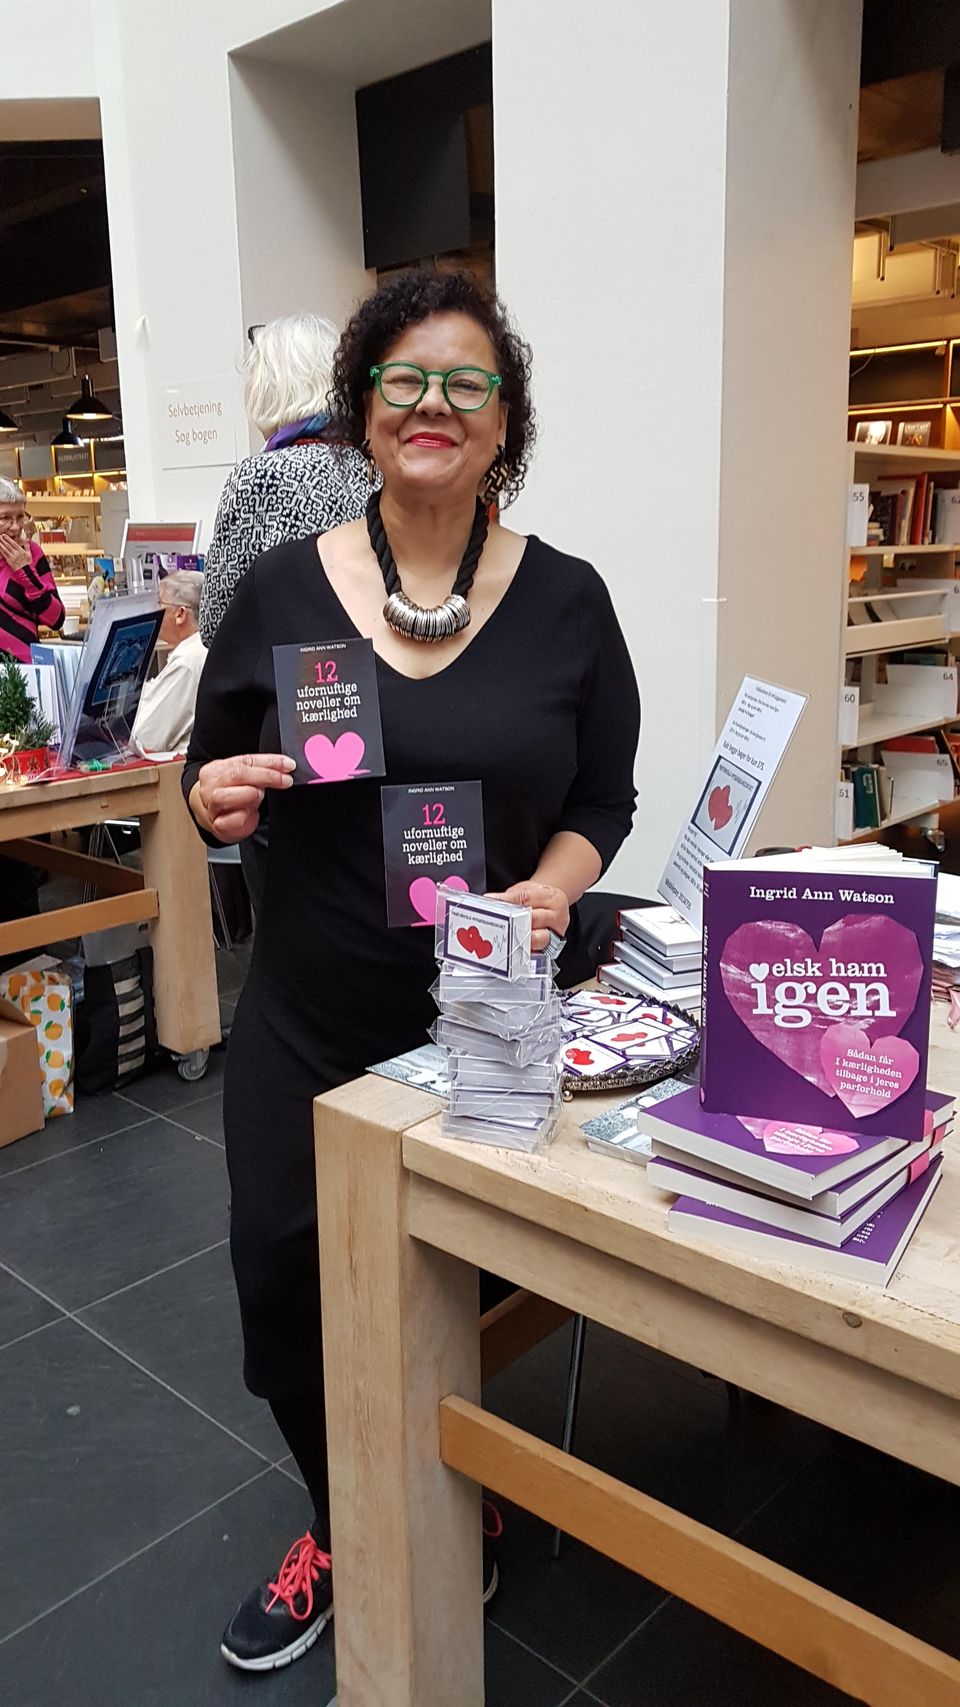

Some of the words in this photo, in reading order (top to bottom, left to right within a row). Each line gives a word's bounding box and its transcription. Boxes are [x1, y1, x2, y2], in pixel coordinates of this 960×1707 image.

[168, 402, 222, 418] Selvbetjening
[192, 428, 217, 444] bogen
[853, 491, 865, 502] 55
[314, 660, 339, 683] 12
[943, 672, 954, 681] 64
[297, 682, 358, 698] ufornuftige
[844, 693, 856, 703] 60
[296, 697, 342, 711] noveller
[343, 695, 361, 706] om
[302, 706, 358, 723] kærlighed
[422, 803, 446, 826] 12
[403, 825, 464, 840] ufornuftige
[402, 838, 447, 852] noveller
[450, 838, 467, 849] om
[408, 850, 463, 866] kærlighed
[749, 886, 798, 901] Ingrid
[801, 888, 834, 901] Ann
[838, 889, 895, 904] Watson
[772, 958, 823, 977] elsk
[829, 957, 888, 977] ham
[750, 980, 897, 1029] igen
[847, 1048, 877, 1062] Sådan
[878, 1052, 894, 1066] får
[835, 1057, 842, 1066] I
[842, 1058, 903, 1079] kærligheden
[835, 1068, 868, 1084] tilbage
[868, 1072, 875, 1083] i
[875, 1074, 900, 1089] jeres
[839, 1080, 892, 1099] parforhold
